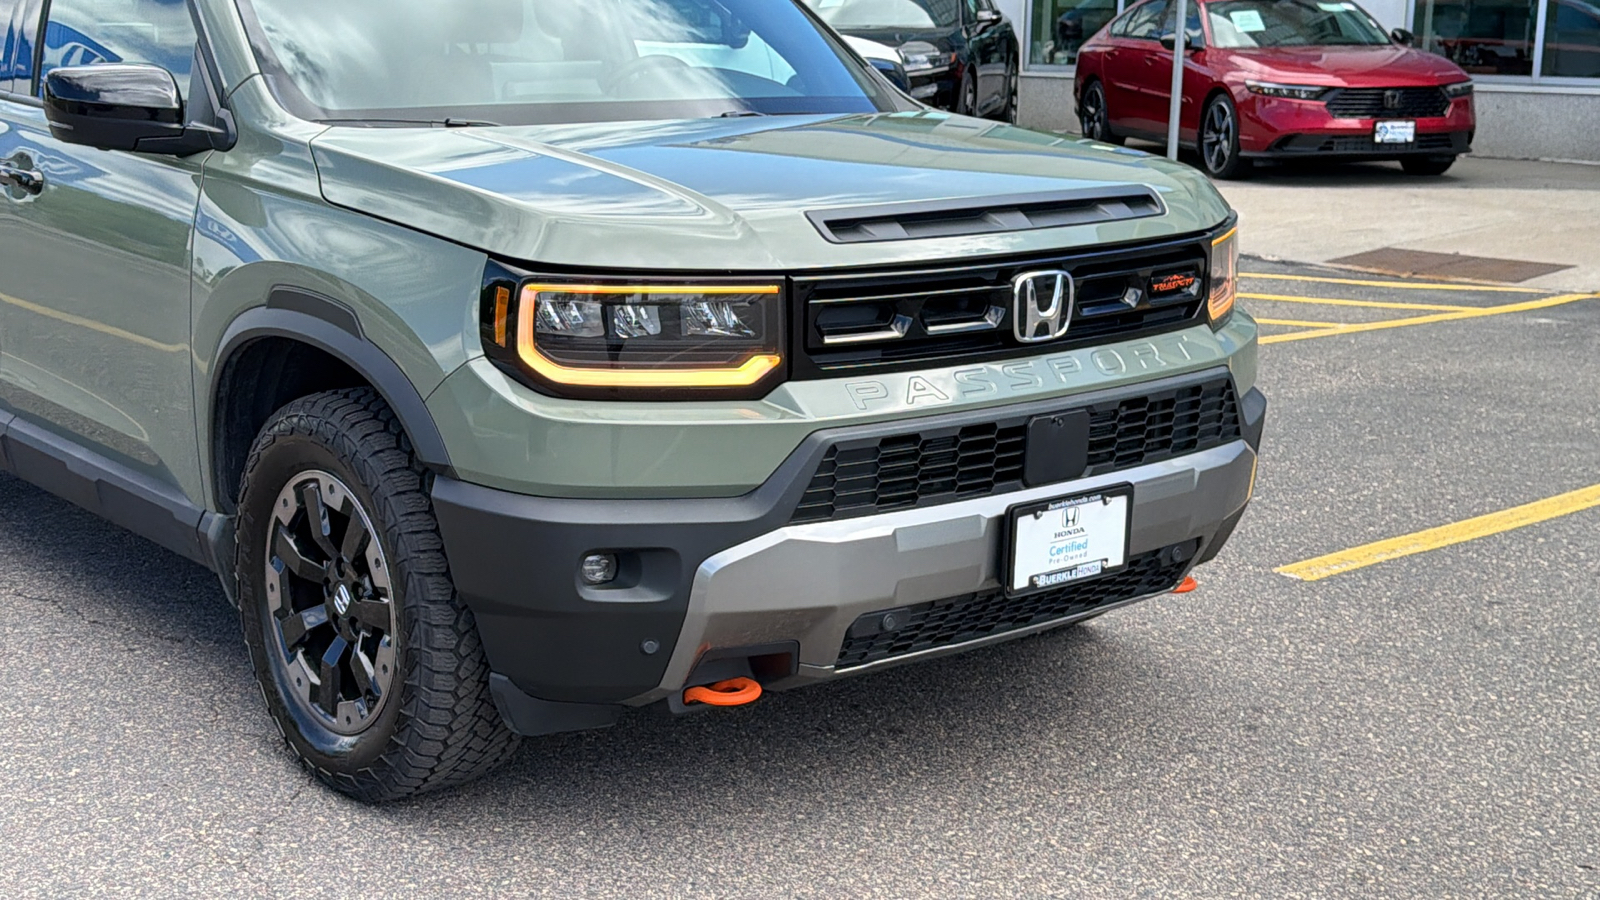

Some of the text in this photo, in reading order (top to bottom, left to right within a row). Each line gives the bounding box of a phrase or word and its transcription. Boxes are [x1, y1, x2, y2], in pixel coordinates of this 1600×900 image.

[844, 334, 1192, 410] PASSPORT
[1053, 527, 1085, 539] HONDA
[1049, 539, 1088, 557] Certified
[1048, 551, 1088, 565] Pre-Owned
